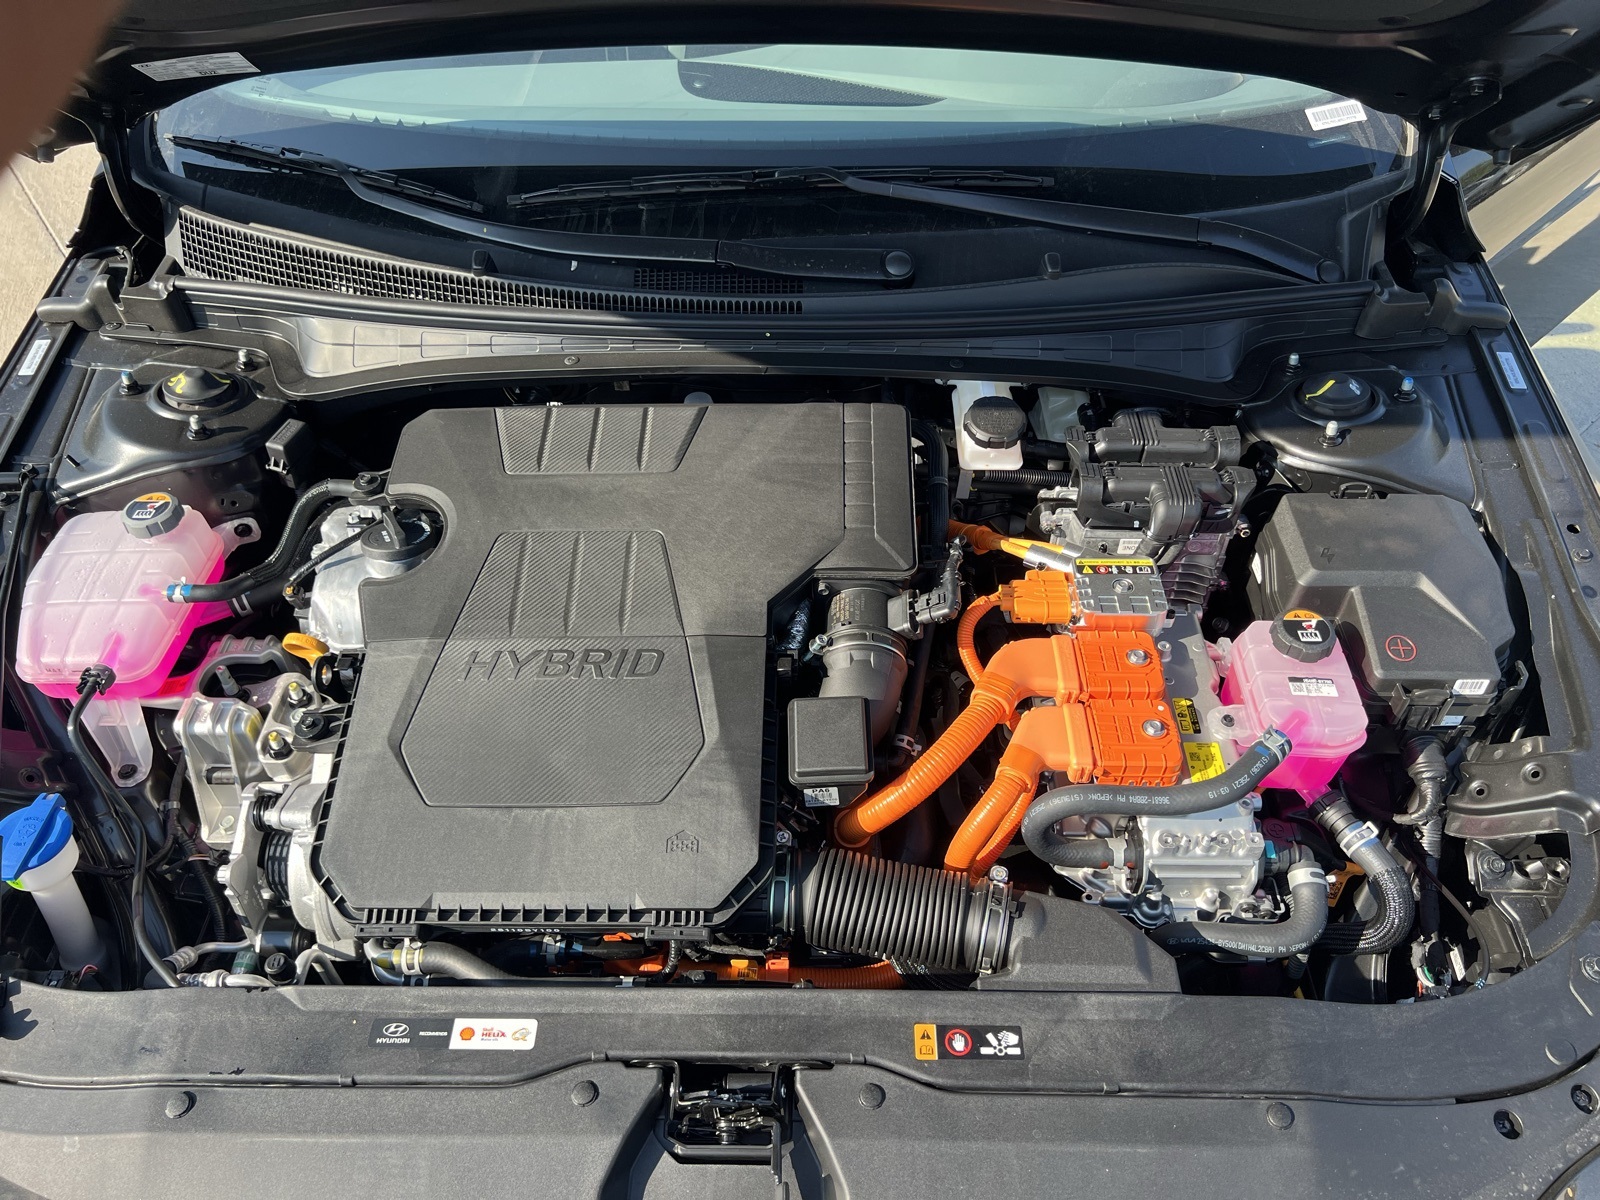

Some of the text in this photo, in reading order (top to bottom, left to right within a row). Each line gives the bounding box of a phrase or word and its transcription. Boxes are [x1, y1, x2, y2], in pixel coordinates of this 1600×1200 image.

[457, 649, 665, 682] HYBRID
[1116, 794, 1126, 803] PH
[481, 1029, 507, 1038] HELIX
